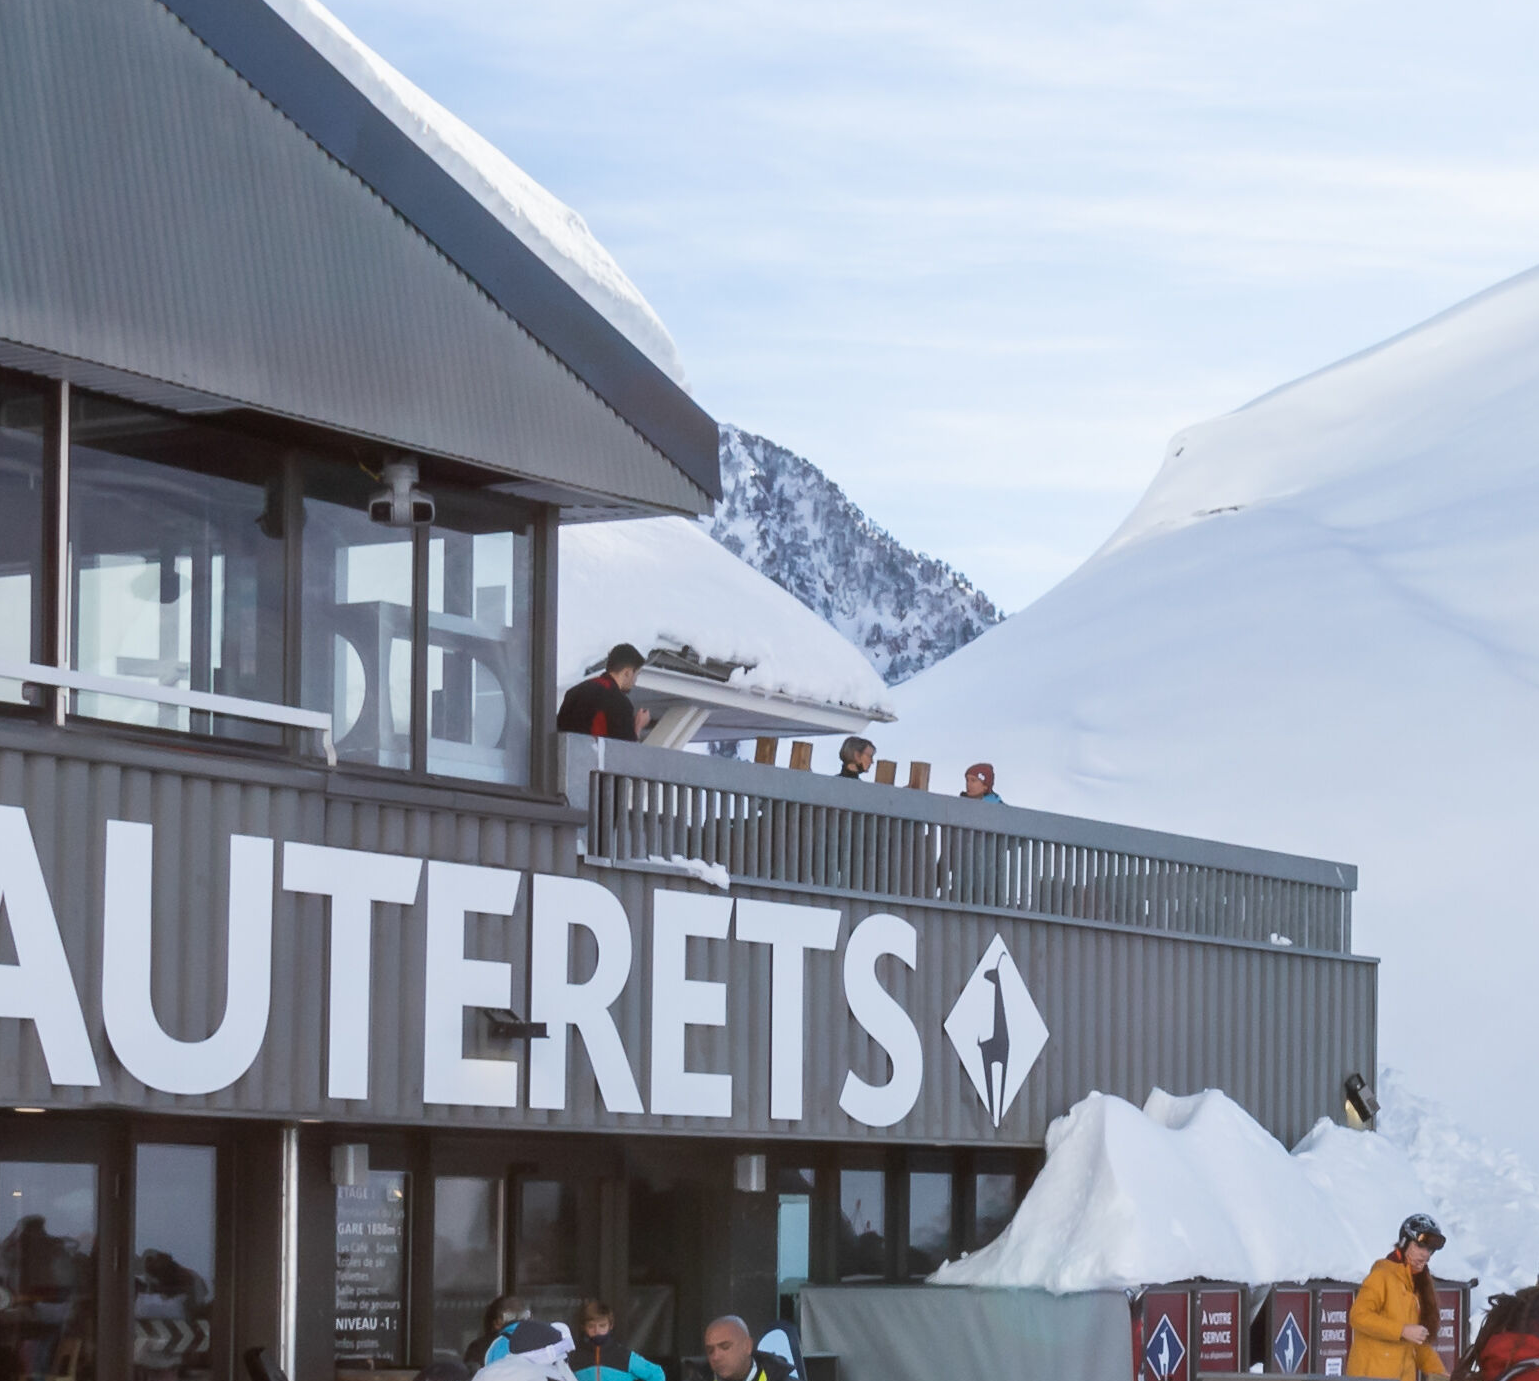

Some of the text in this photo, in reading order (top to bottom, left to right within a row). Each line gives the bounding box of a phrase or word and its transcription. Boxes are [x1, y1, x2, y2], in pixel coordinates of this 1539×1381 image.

[337, 1222, 364, 1236] GARE
[335, 1317, 378, 1331] NIVEAU
[1209, 1311, 1232, 1325] VOTRE
[1203, 1331, 1231, 1344] SERVICE
[1322, 1329, 1346, 1342] SERVICE
